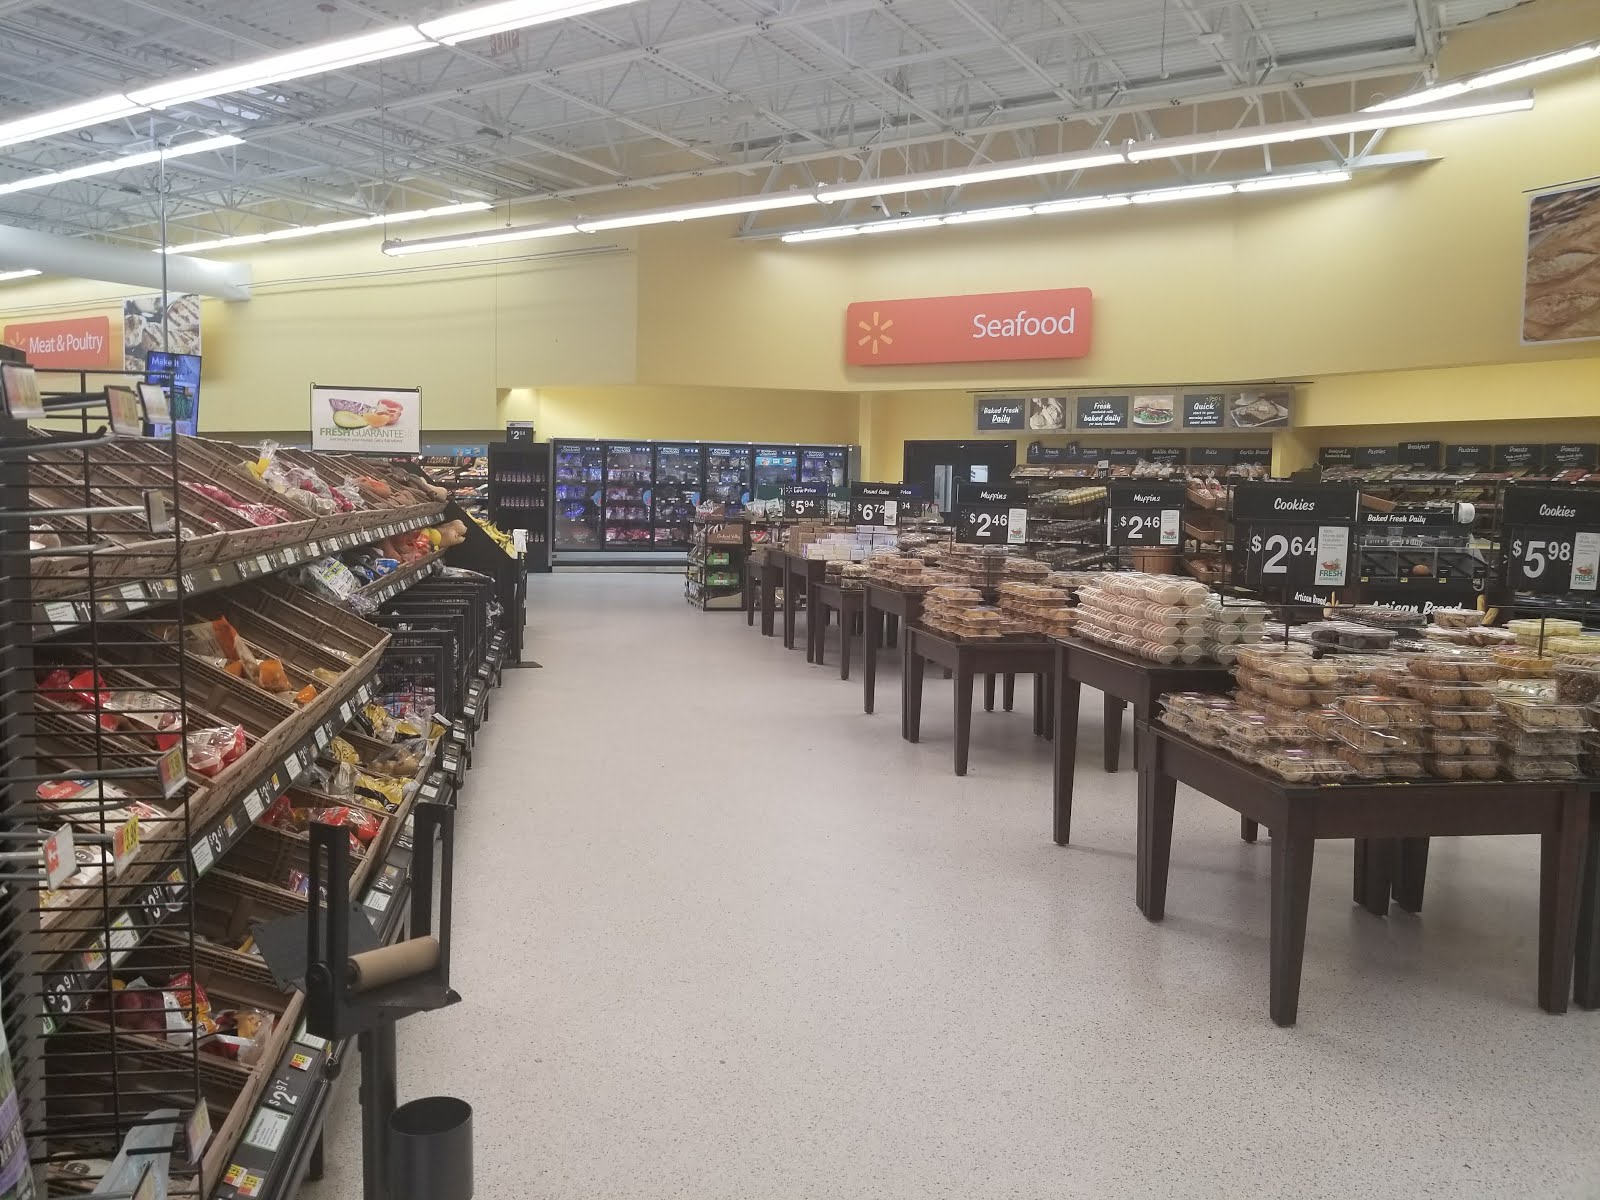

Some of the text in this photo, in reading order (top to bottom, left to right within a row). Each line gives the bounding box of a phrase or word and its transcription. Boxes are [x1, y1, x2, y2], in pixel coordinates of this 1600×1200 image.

[972, 308, 1075, 339] Seafood
[29, 332, 103, 354] Meat & Poultry
[984, 406, 1002, 414] Baked
[1093, 402, 1111, 410] Fresh
[1193, 402, 1214, 410] Quick
[991, 415, 1011, 424] Daily
[1083, 414, 1121, 423] baked daily
[320, 427, 405, 439] FRESH GUARANTEE
[1133, 494, 1161, 504] Muffins
[1273, 498, 1315, 512] Cookies
[1539, 503, 1577, 518] Cookies
[1367, 514, 1427, 525] Baked Fresh Daily
[1319, 569, 1343, 577] FRESH
[1574, 574, 1595, 582] FRESH
[1294, 591, 1327, 605] Artisan Bread
